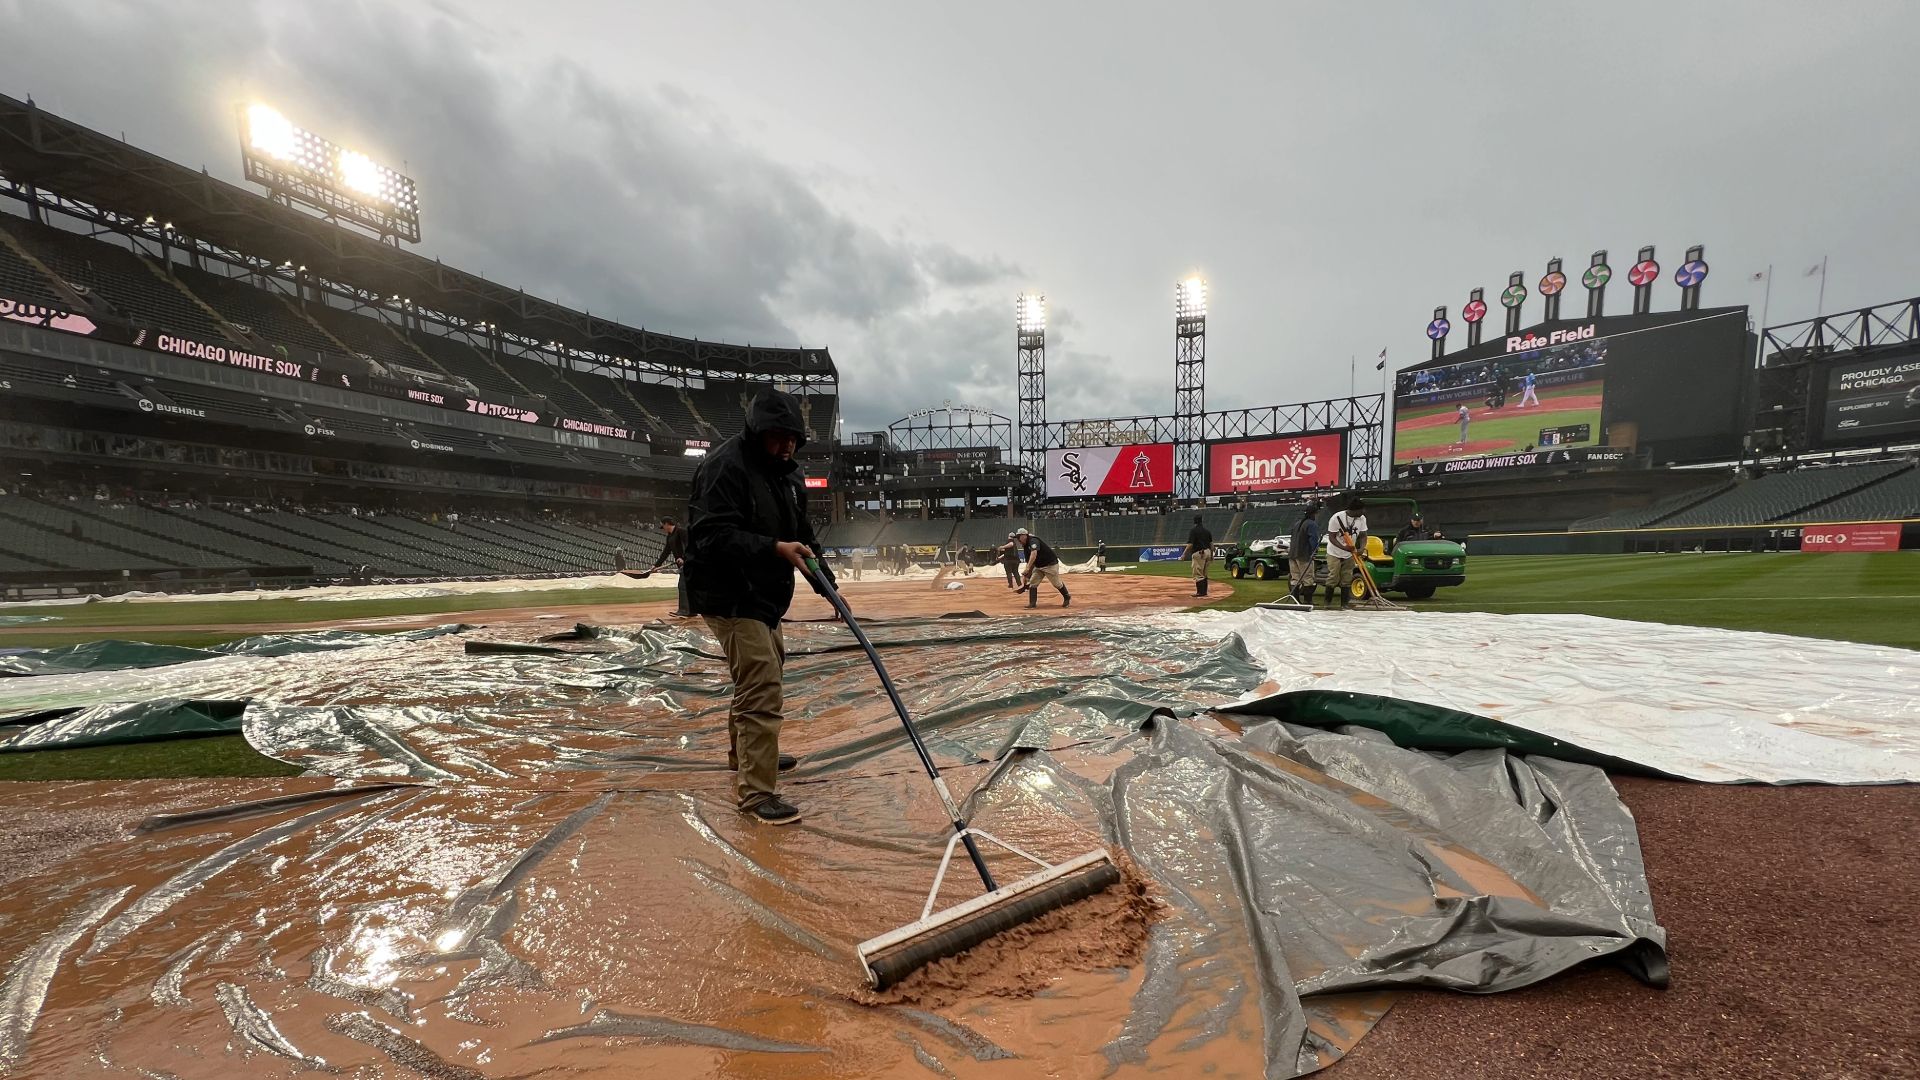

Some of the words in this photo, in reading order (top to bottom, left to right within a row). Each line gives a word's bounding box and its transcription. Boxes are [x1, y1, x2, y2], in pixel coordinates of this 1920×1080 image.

[1506, 335, 1548, 353] Rate
[1550, 324, 1595, 345] Field
[158, 334, 226, 362] CHICAGO
[229, 349, 274, 373] WHITE
[275, 360, 302, 378] SOX
[1841, 366, 1892, 381] PROUDLY
[1840, 382, 1852, 391] IN
[1854, 374, 1905, 388] CHICAGO.
[408, 389, 430, 402] WHITE
[430, 394, 444, 404] SOX
[156, 403, 206, 418] BUEHRLE
[908, 406, 937, 420] KIDS
[960, 403, 994, 418] ZONE
[317, 428, 336, 437] FISK
[563, 418, 593, 433] CHICAGO
[593, 423, 614, 437] WHITE
[614, 427, 628, 439] SOX
[685, 439, 700, 448] WHITE
[701, 440, 711, 448] SOX
[1445, 458, 1484, 472] CHICAGO
[1486, 456, 1516, 470] WHITE
[1517, 453, 1538, 465] SOX
[1113, 495, 1134, 504] Modelo
[1804, 534, 1833, 544] CIBC
